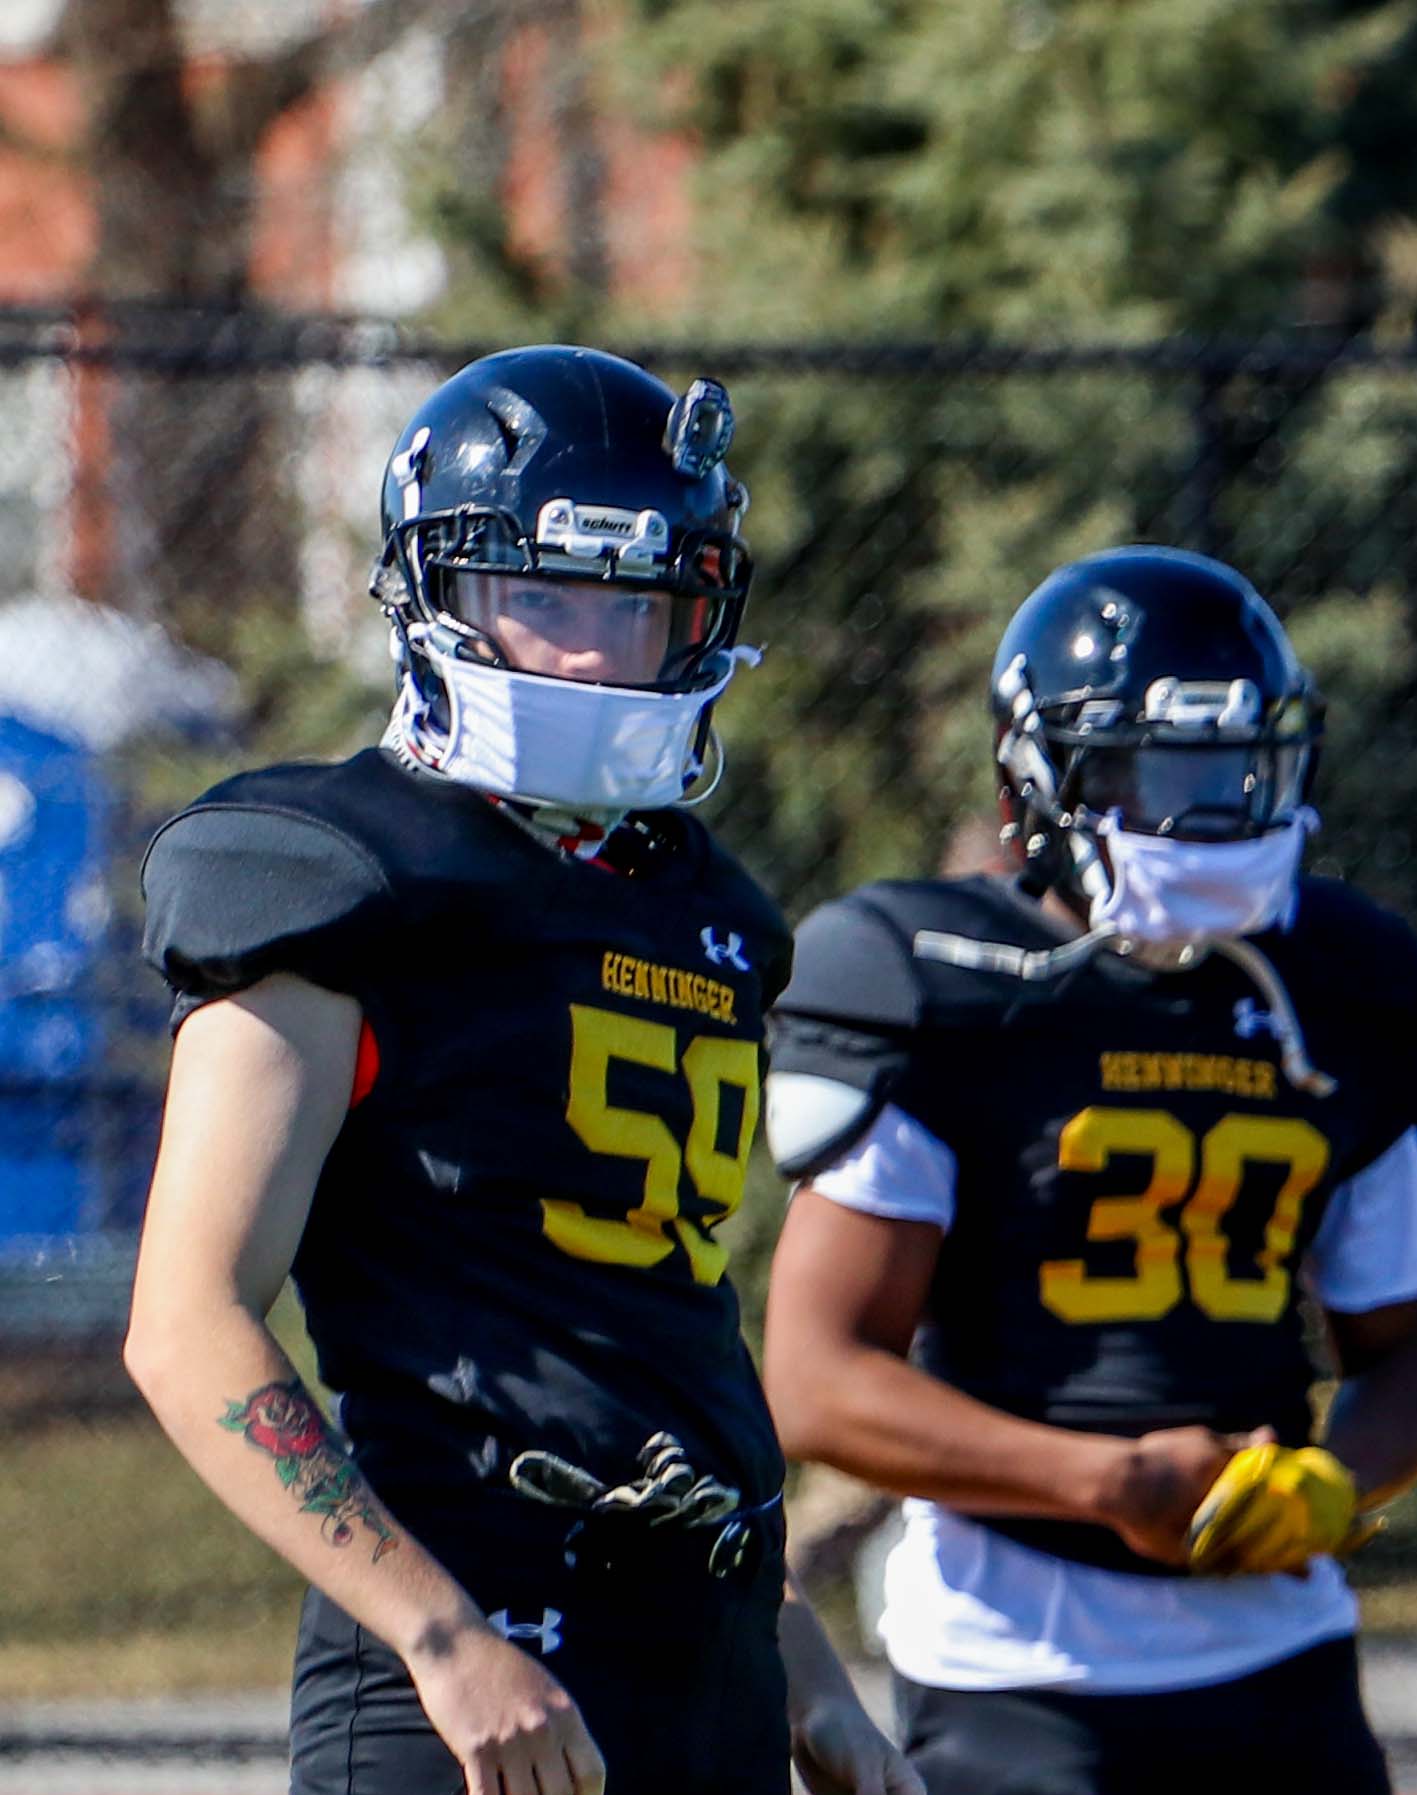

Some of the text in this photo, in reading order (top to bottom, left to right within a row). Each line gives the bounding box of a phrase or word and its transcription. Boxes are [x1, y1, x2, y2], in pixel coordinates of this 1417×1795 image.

[602, 950, 738, 1026] HENNINGER
[539, 1003, 762, 1287] 59
[1040, 1105, 1331, 1325] 30
